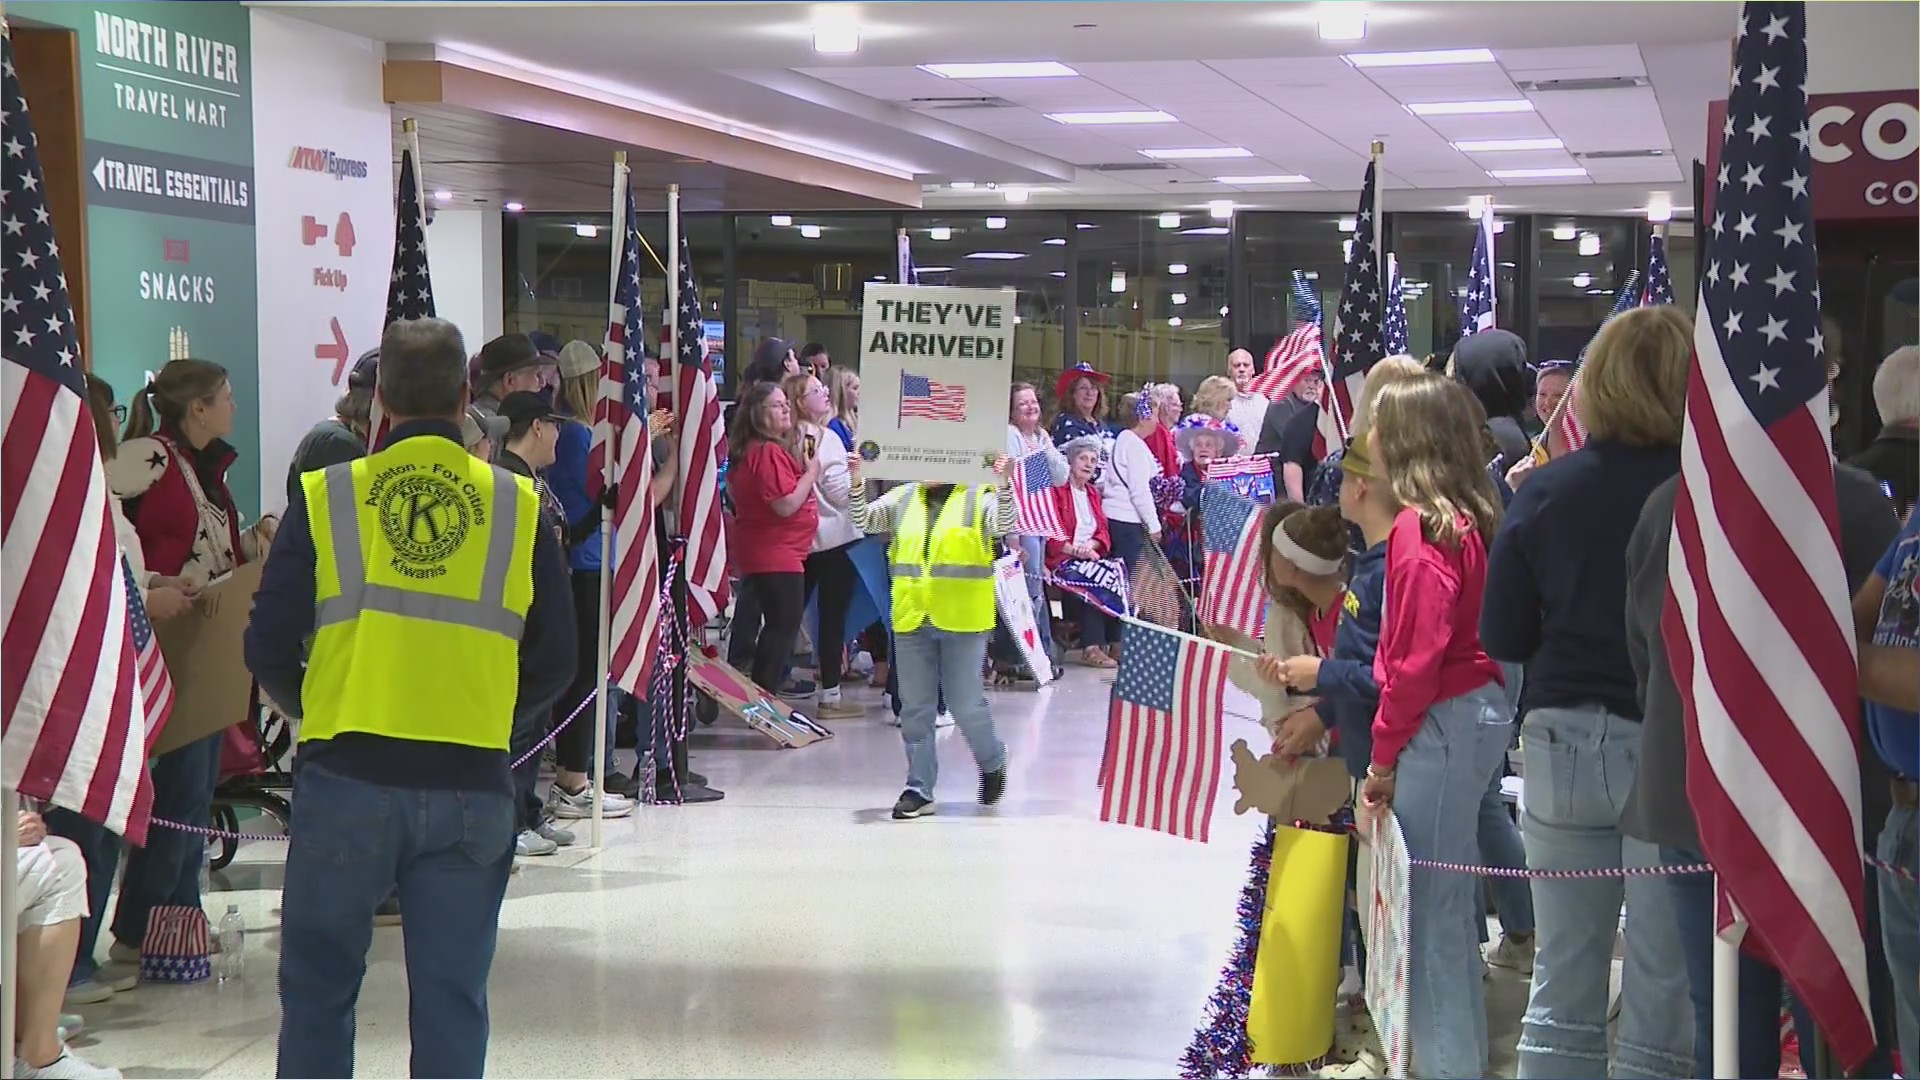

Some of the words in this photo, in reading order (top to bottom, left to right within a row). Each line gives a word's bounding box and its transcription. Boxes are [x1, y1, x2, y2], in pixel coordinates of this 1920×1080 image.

[94, 10, 168, 68] NORTH
[175, 31, 239, 84] RIVER
[114, 82, 178, 120] TRAVEL
[185, 98, 226, 128] MART
[329, 150, 368, 180] Express
[106, 160, 162, 195] TRAVEL
[166, 170, 248, 207] ESSENTIALS
[139, 270, 215, 304] SNACKS
[313, 267, 332, 287] Pick
[333, 271, 348, 292] Up
[876, 299, 1003, 329] THEY'VE
[868, 331, 1004, 360] ARRIVED!
[365, 463, 416, 507] Appleton
[432, 463, 462, 484] Fox
[462, 483, 485, 527] Cities
[399, 483, 454, 507] KIWANIS
[390, 513, 458, 554] INTERNATIONAL
[390, 555, 447, 579] Kiwanis
